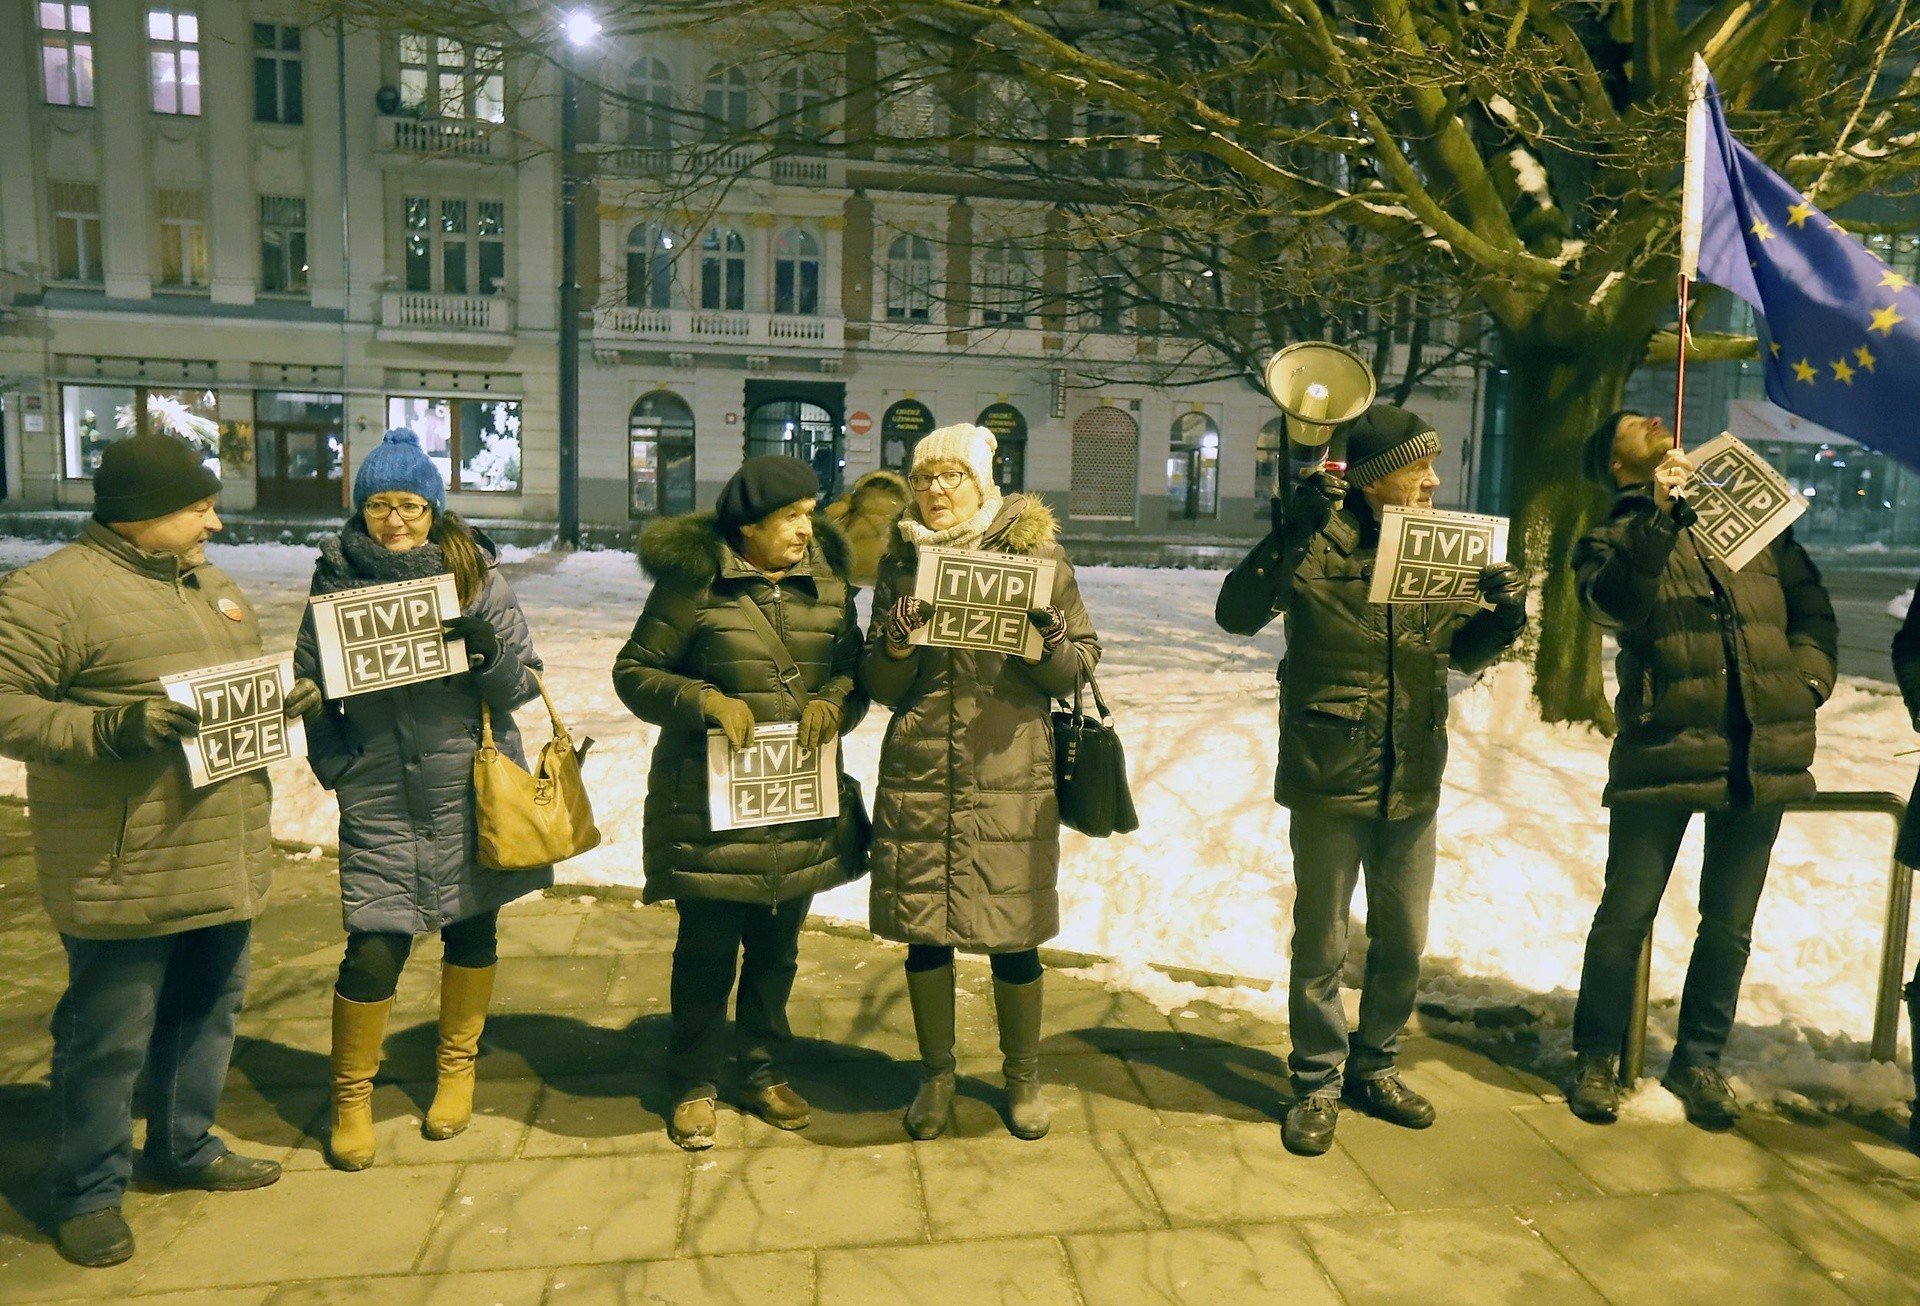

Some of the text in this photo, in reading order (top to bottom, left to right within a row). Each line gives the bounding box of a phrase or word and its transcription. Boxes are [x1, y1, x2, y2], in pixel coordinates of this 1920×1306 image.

[1711, 456, 1773, 510] TVP
[1409, 529, 1485, 562] TVP
[945, 568, 1025, 602] TVP
[1400, 571, 1479, 596] ŁŻE
[345, 599, 429, 637] TVP
[938, 610, 1020, 644] ŁŻE
[354, 640, 441, 681] ŁŻE
[202, 679, 276, 720] TVP
[208, 722, 281, 768] ŁŻE
[737, 744, 812, 773] TVP
[738, 783, 814, 816] ŁŻE
